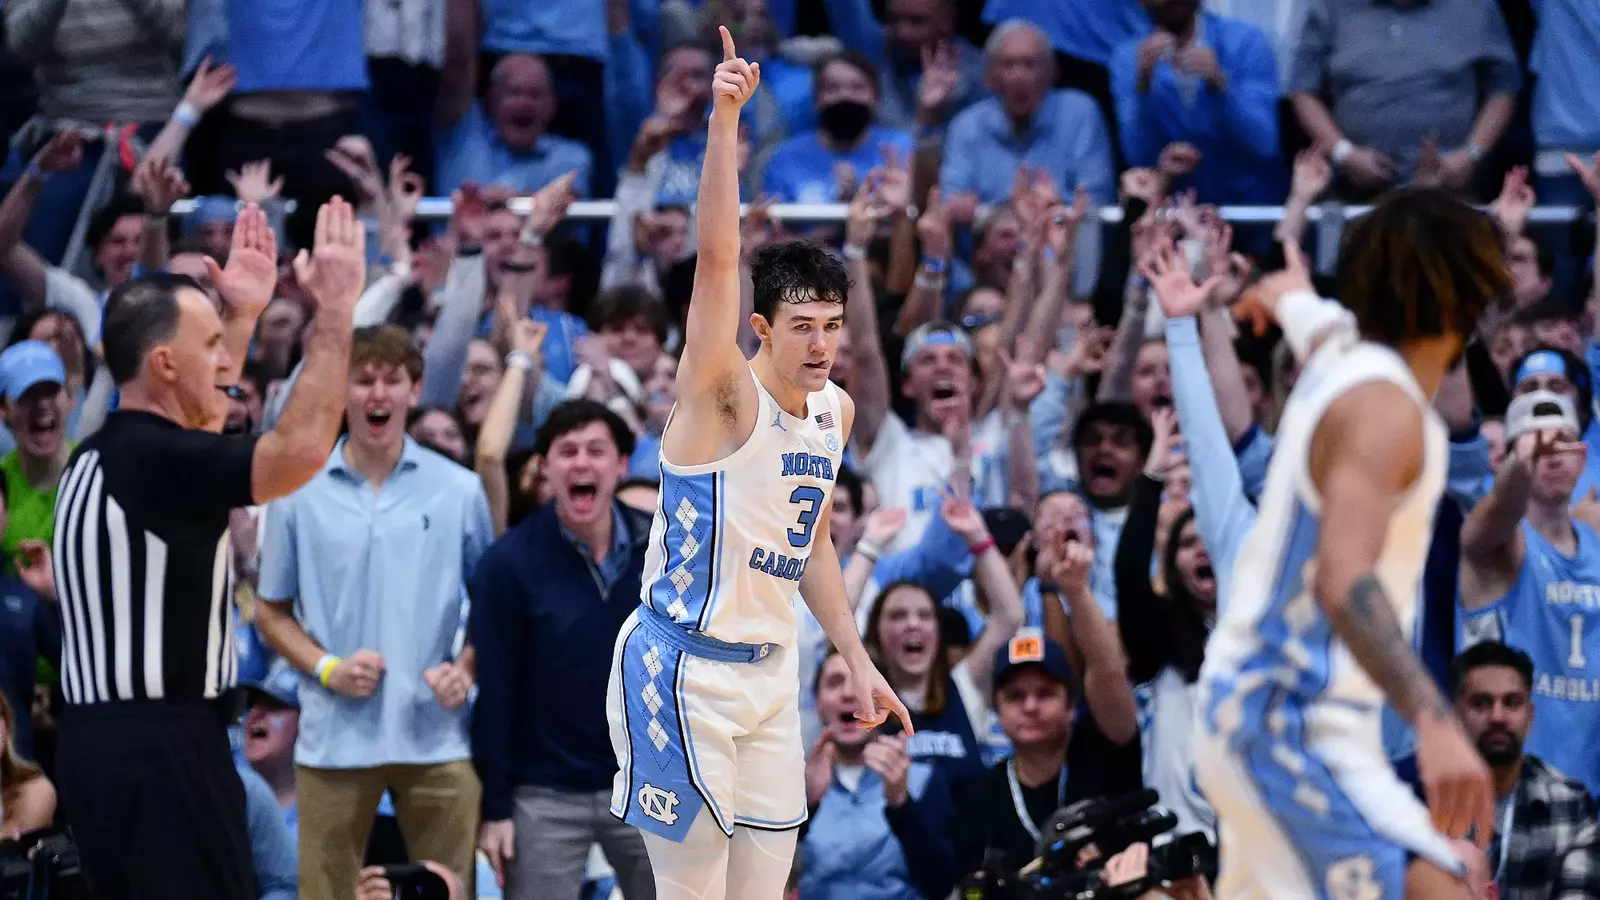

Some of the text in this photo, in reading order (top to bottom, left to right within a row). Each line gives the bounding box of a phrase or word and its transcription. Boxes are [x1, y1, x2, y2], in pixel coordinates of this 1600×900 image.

[786, 485, 826, 548] 3
[749, 547, 810, 581] CAROL
[1567, 613, 1586, 670] 1
